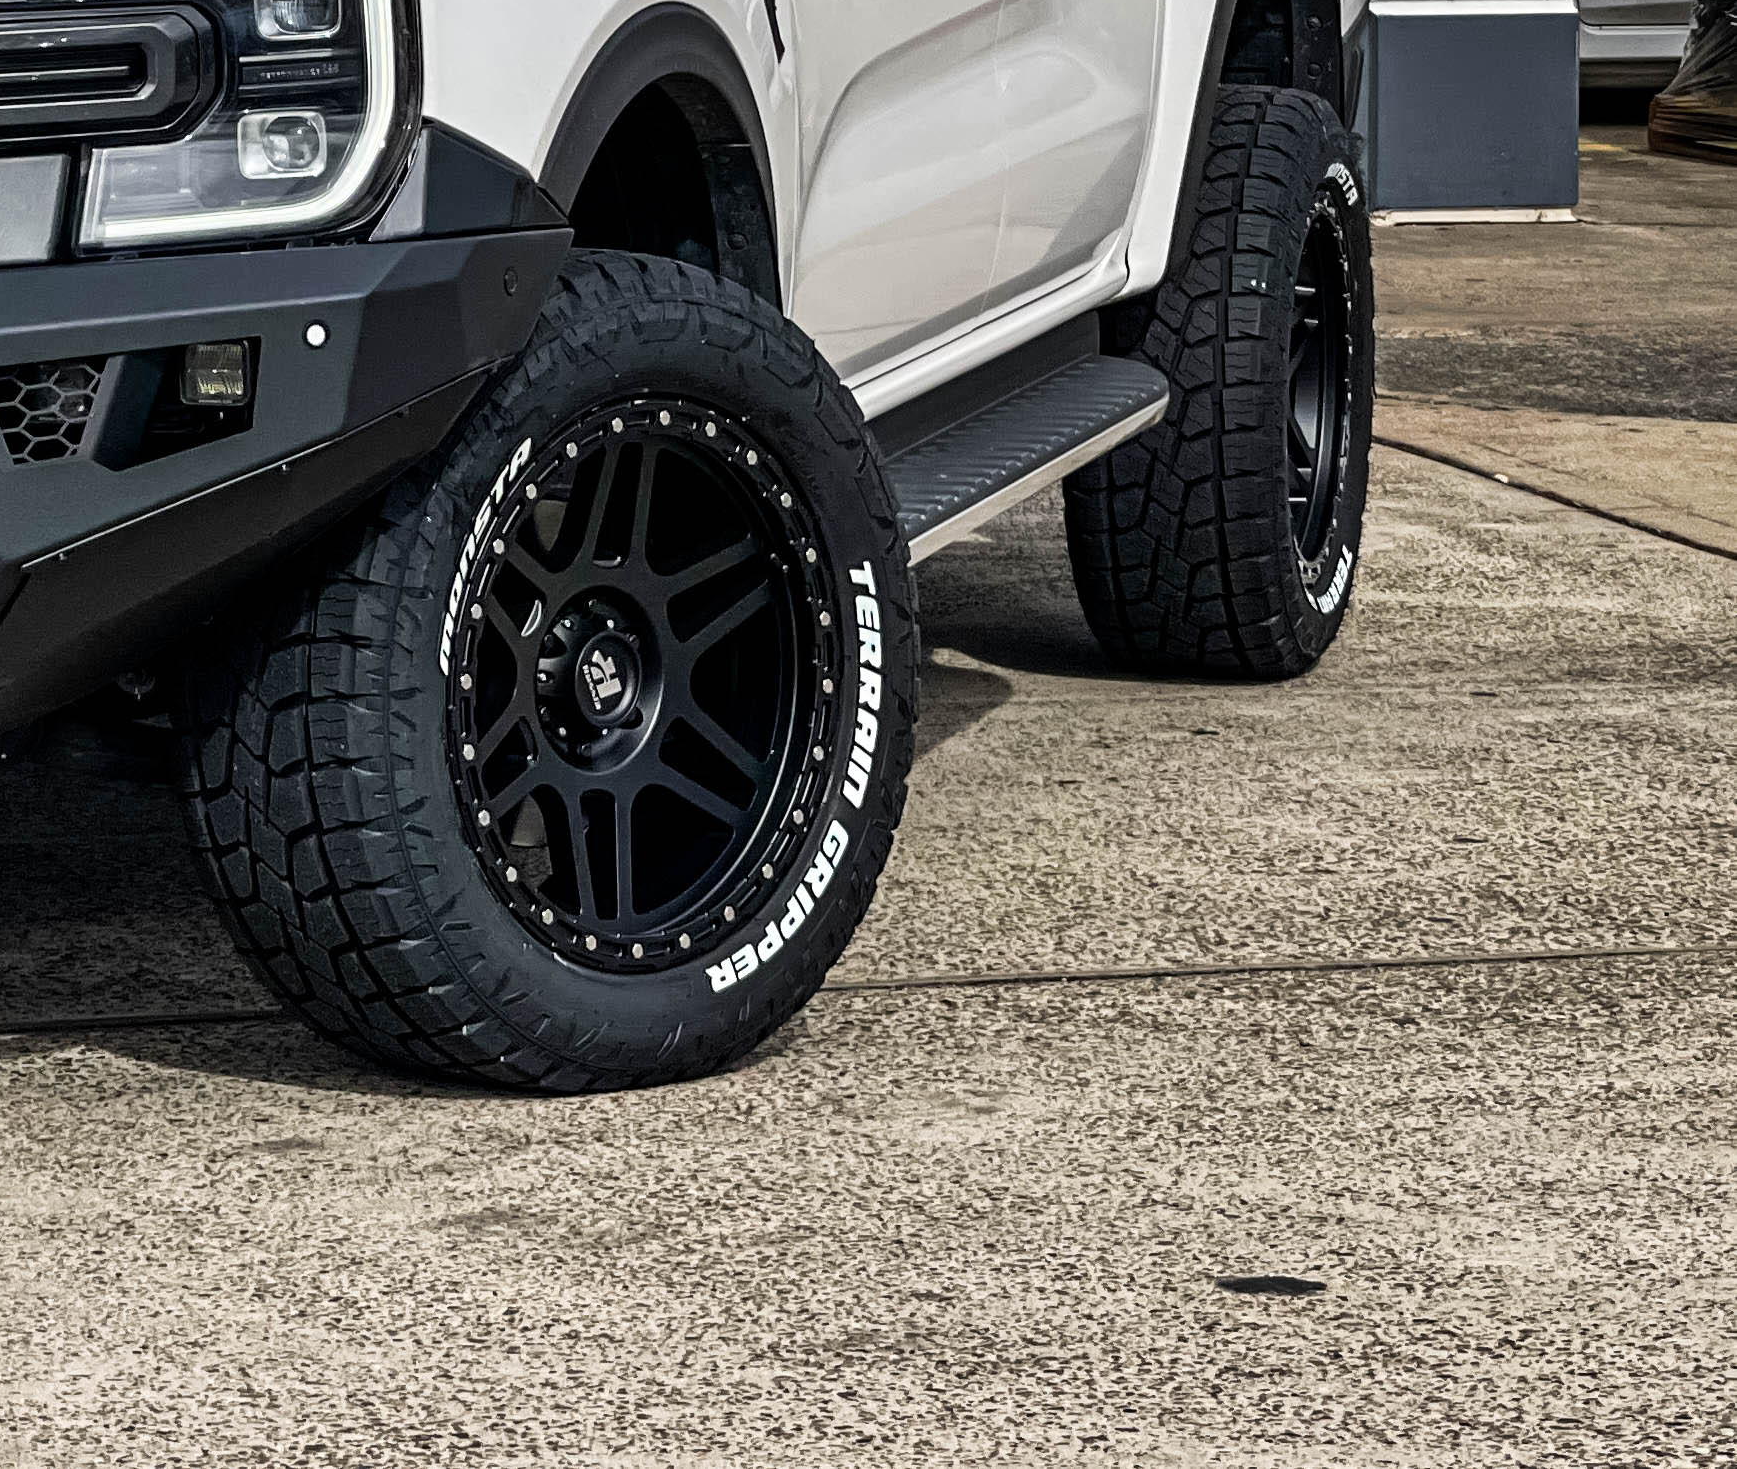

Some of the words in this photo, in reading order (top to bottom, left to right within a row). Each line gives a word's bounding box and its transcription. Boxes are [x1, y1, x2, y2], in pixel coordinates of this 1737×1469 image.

[439, 437, 532, 676] MONSTA
[842, 560, 883, 809] TERRAIN
[704, 818, 849, 994] GRIPPER
